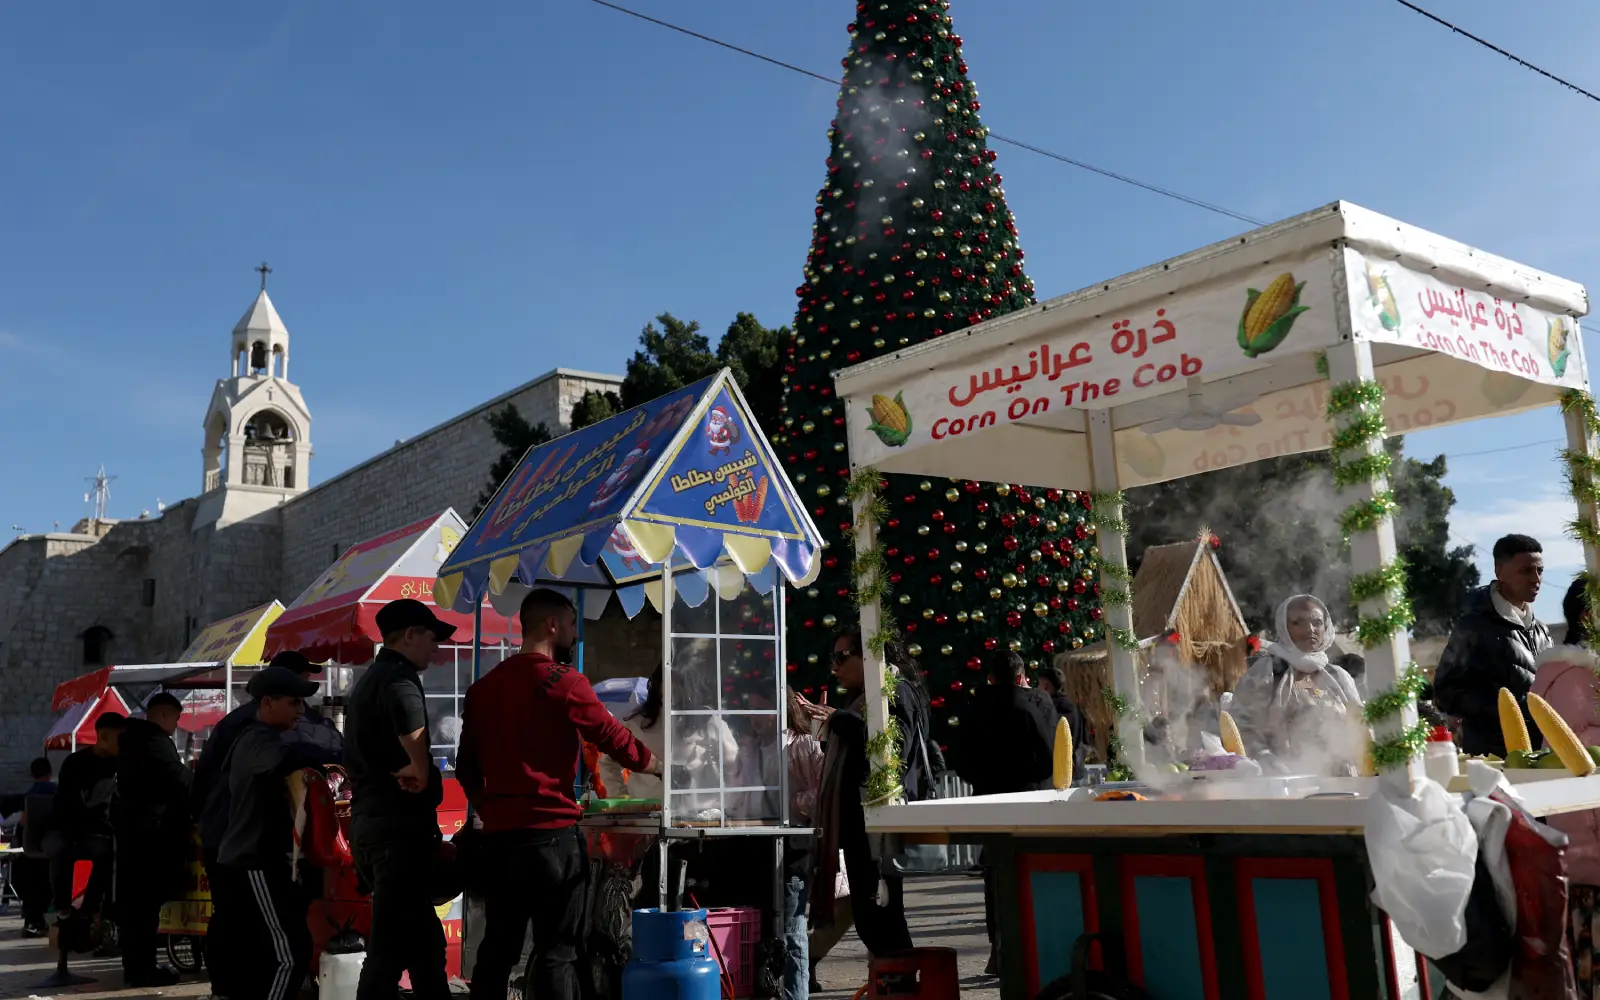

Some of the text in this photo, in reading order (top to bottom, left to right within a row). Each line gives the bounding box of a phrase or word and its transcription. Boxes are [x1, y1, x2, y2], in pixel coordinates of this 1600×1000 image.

[1418, 287, 1523, 340] ذرة عرانيس
[949, 308, 1176, 407] ذرة عرانيس
[1457, 335, 1480, 360] On
[1479, 341, 1511, 369] The
[1512, 349, 1539, 377] Cob
[931, 353, 1203, 440] Corn On The Cob
[670, 450, 758, 492] شيبس بطاطا
